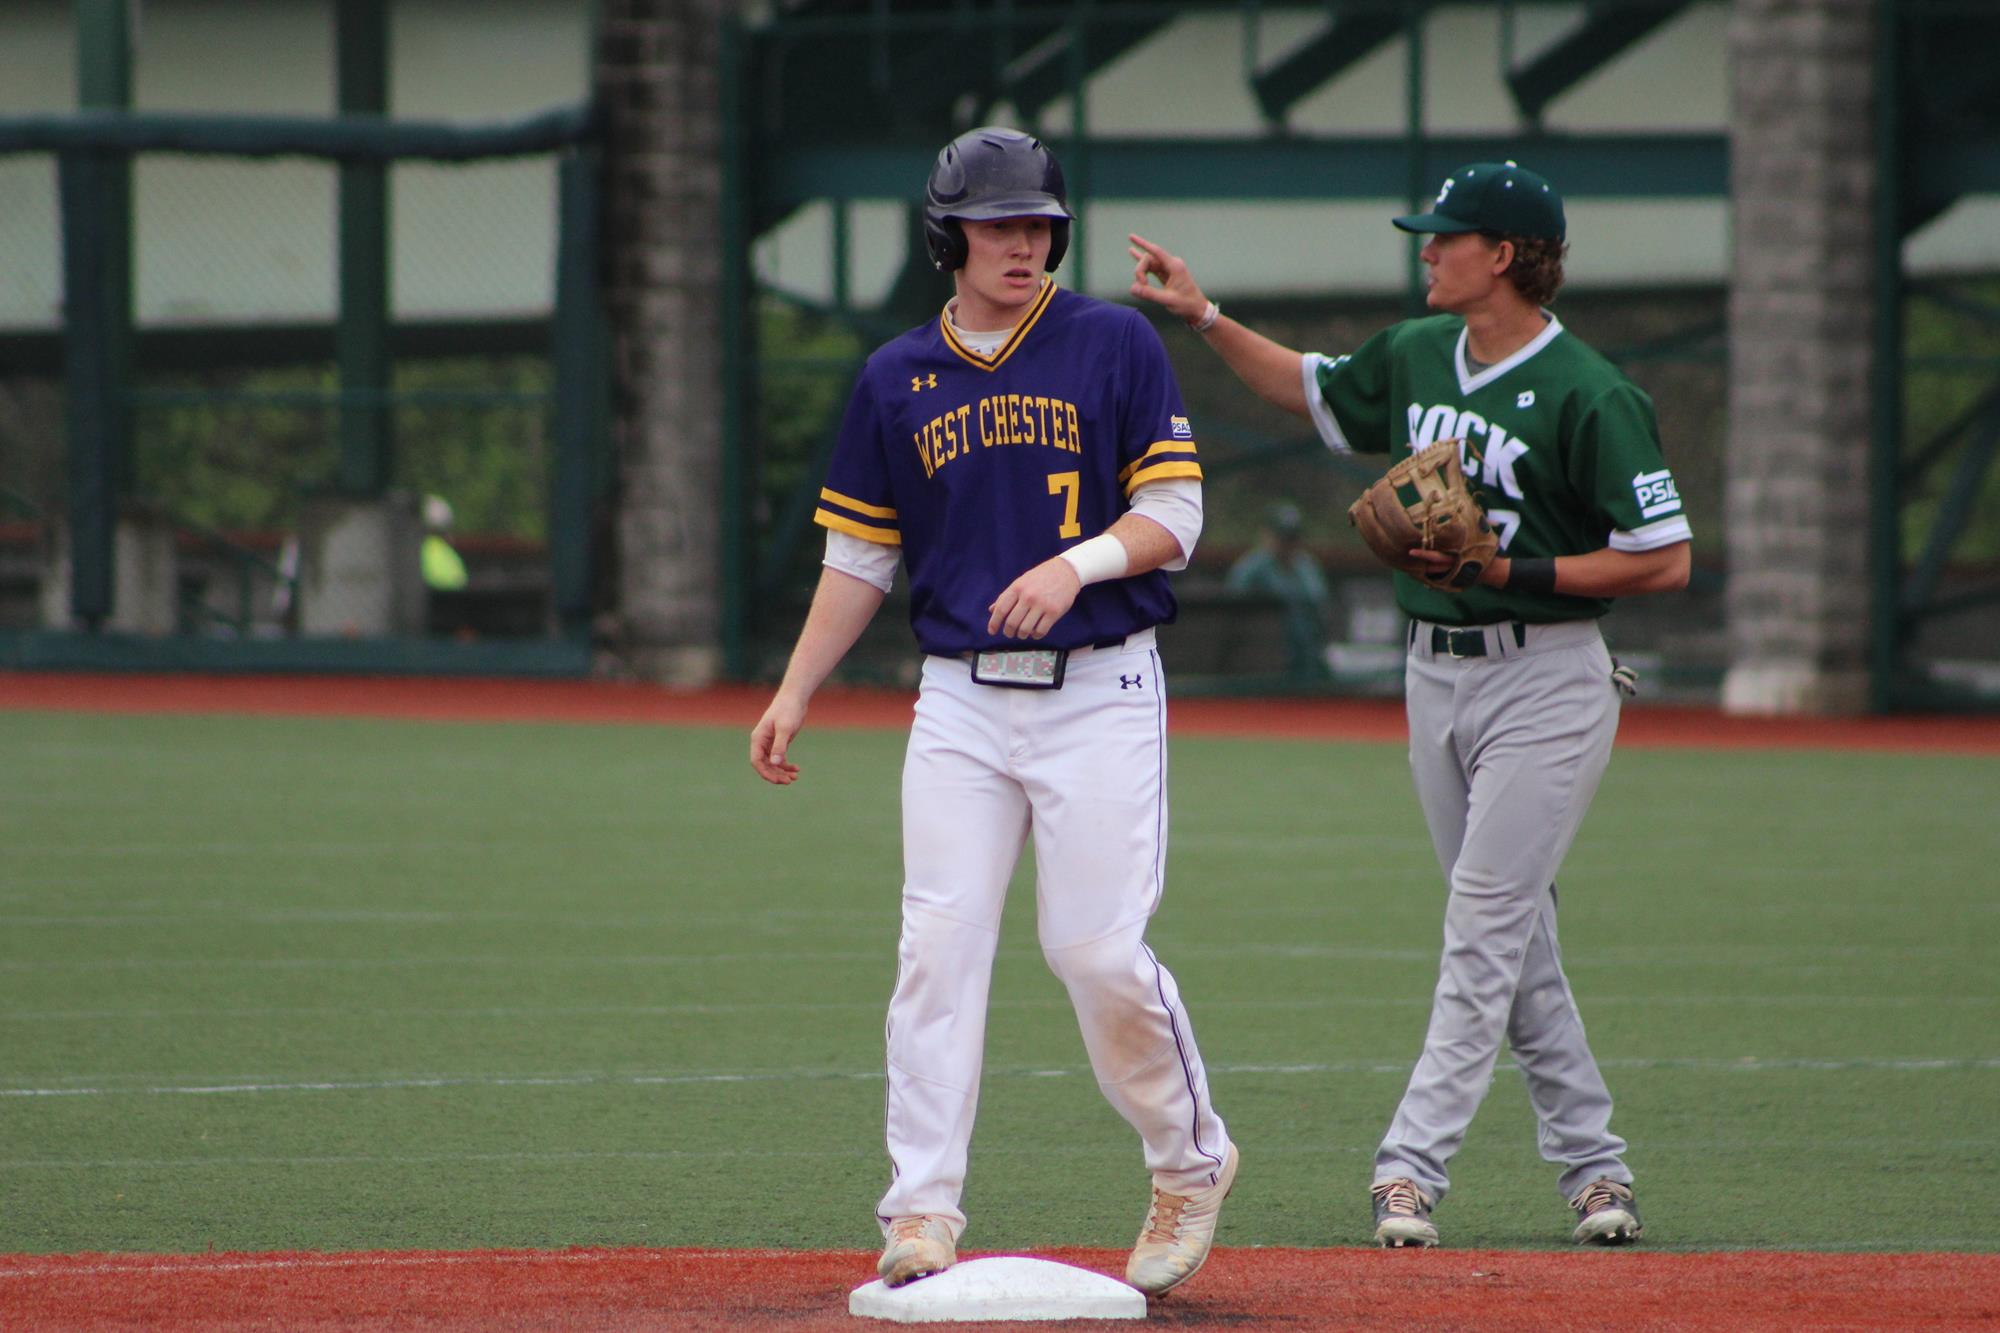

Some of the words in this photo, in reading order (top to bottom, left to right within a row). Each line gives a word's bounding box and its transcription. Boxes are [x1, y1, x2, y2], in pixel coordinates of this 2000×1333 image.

[913, 404, 970, 479] WEST
[979, 394, 1082, 455] CHESTER
[1047, 470, 1081, 539] 7
